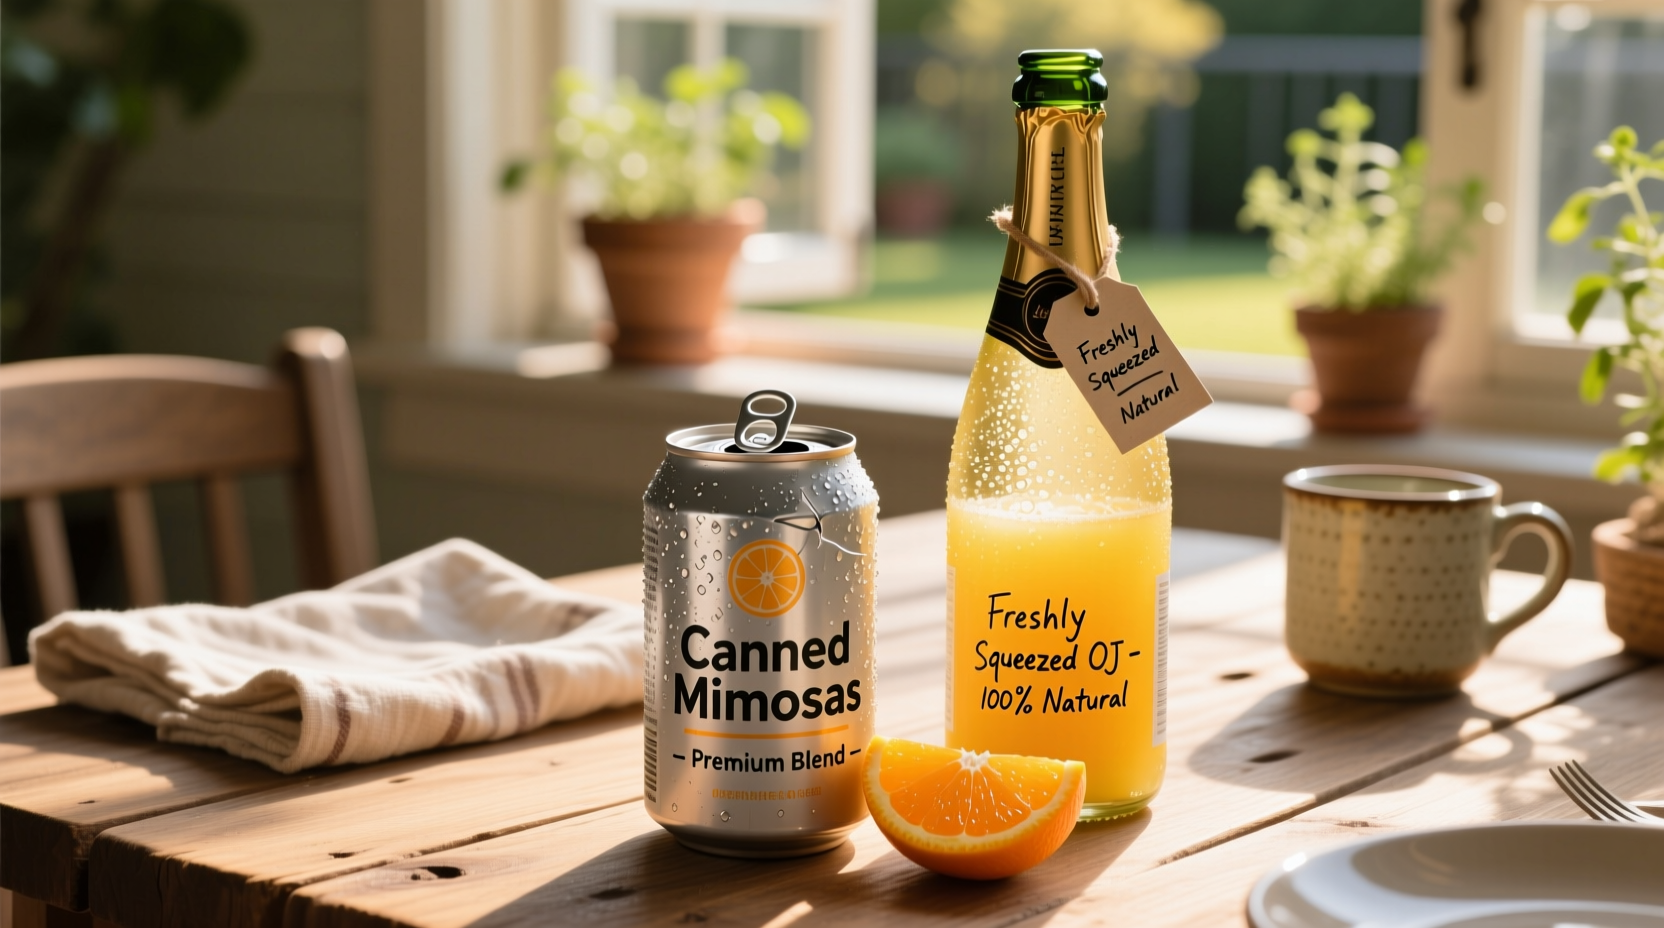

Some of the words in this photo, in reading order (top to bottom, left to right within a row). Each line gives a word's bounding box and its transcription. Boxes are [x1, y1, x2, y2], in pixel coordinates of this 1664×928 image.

[1076, 322, 1139, 365] Freshly
[1088, 334, 1160, 392] Squeezed
[1120, 372, 1180, 424] Natural
[988, 592, 1086, 642] Freshly
[681, 620, 850, 672] Canned
[975, 640, 1078, 683] Squeezed
[674, 672, 861, 722] Mimosas
[981, 685, 1033, 715] 100%
[1042, 679, 1129, 714] Natural
[692, 748, 785, 773] Premium
[791, 743, 845, 771] Blend
